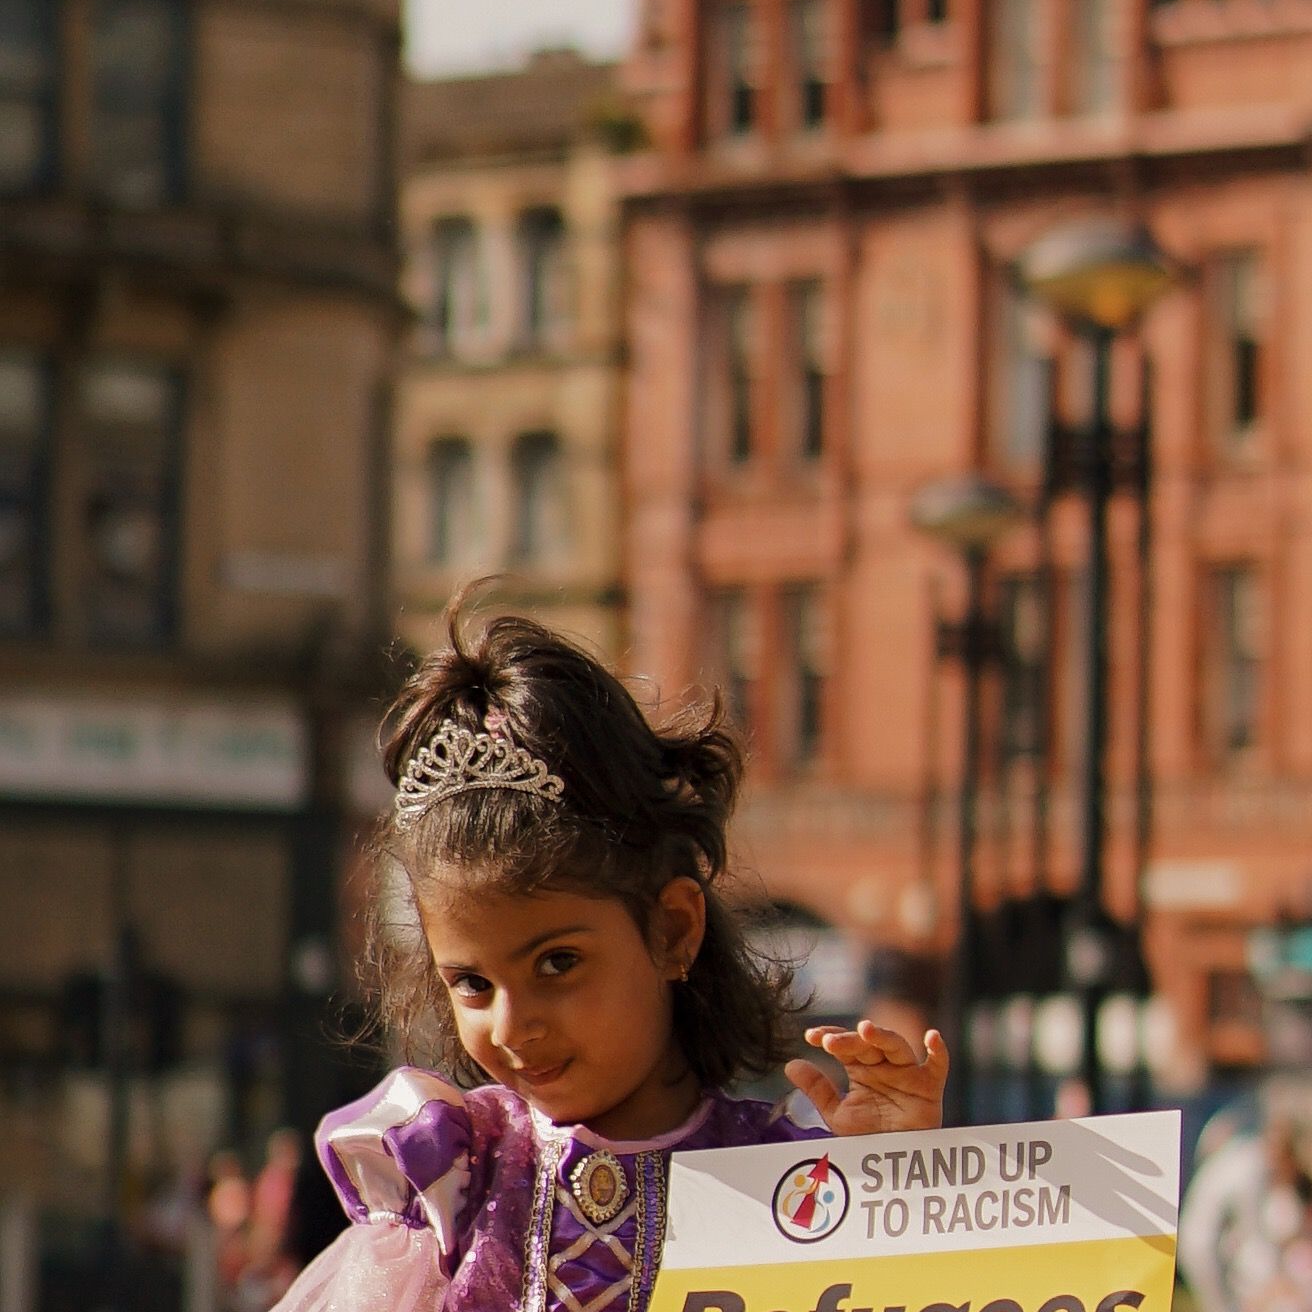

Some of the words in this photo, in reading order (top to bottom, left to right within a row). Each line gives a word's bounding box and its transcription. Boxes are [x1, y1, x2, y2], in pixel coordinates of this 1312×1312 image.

[861, 1145, 986, 1193] STAND
[998, 1140, 1053, 1183] UP
[860, 1198, 910, 1239] TO
[921, 1184, 1071, 1235] RACISM
